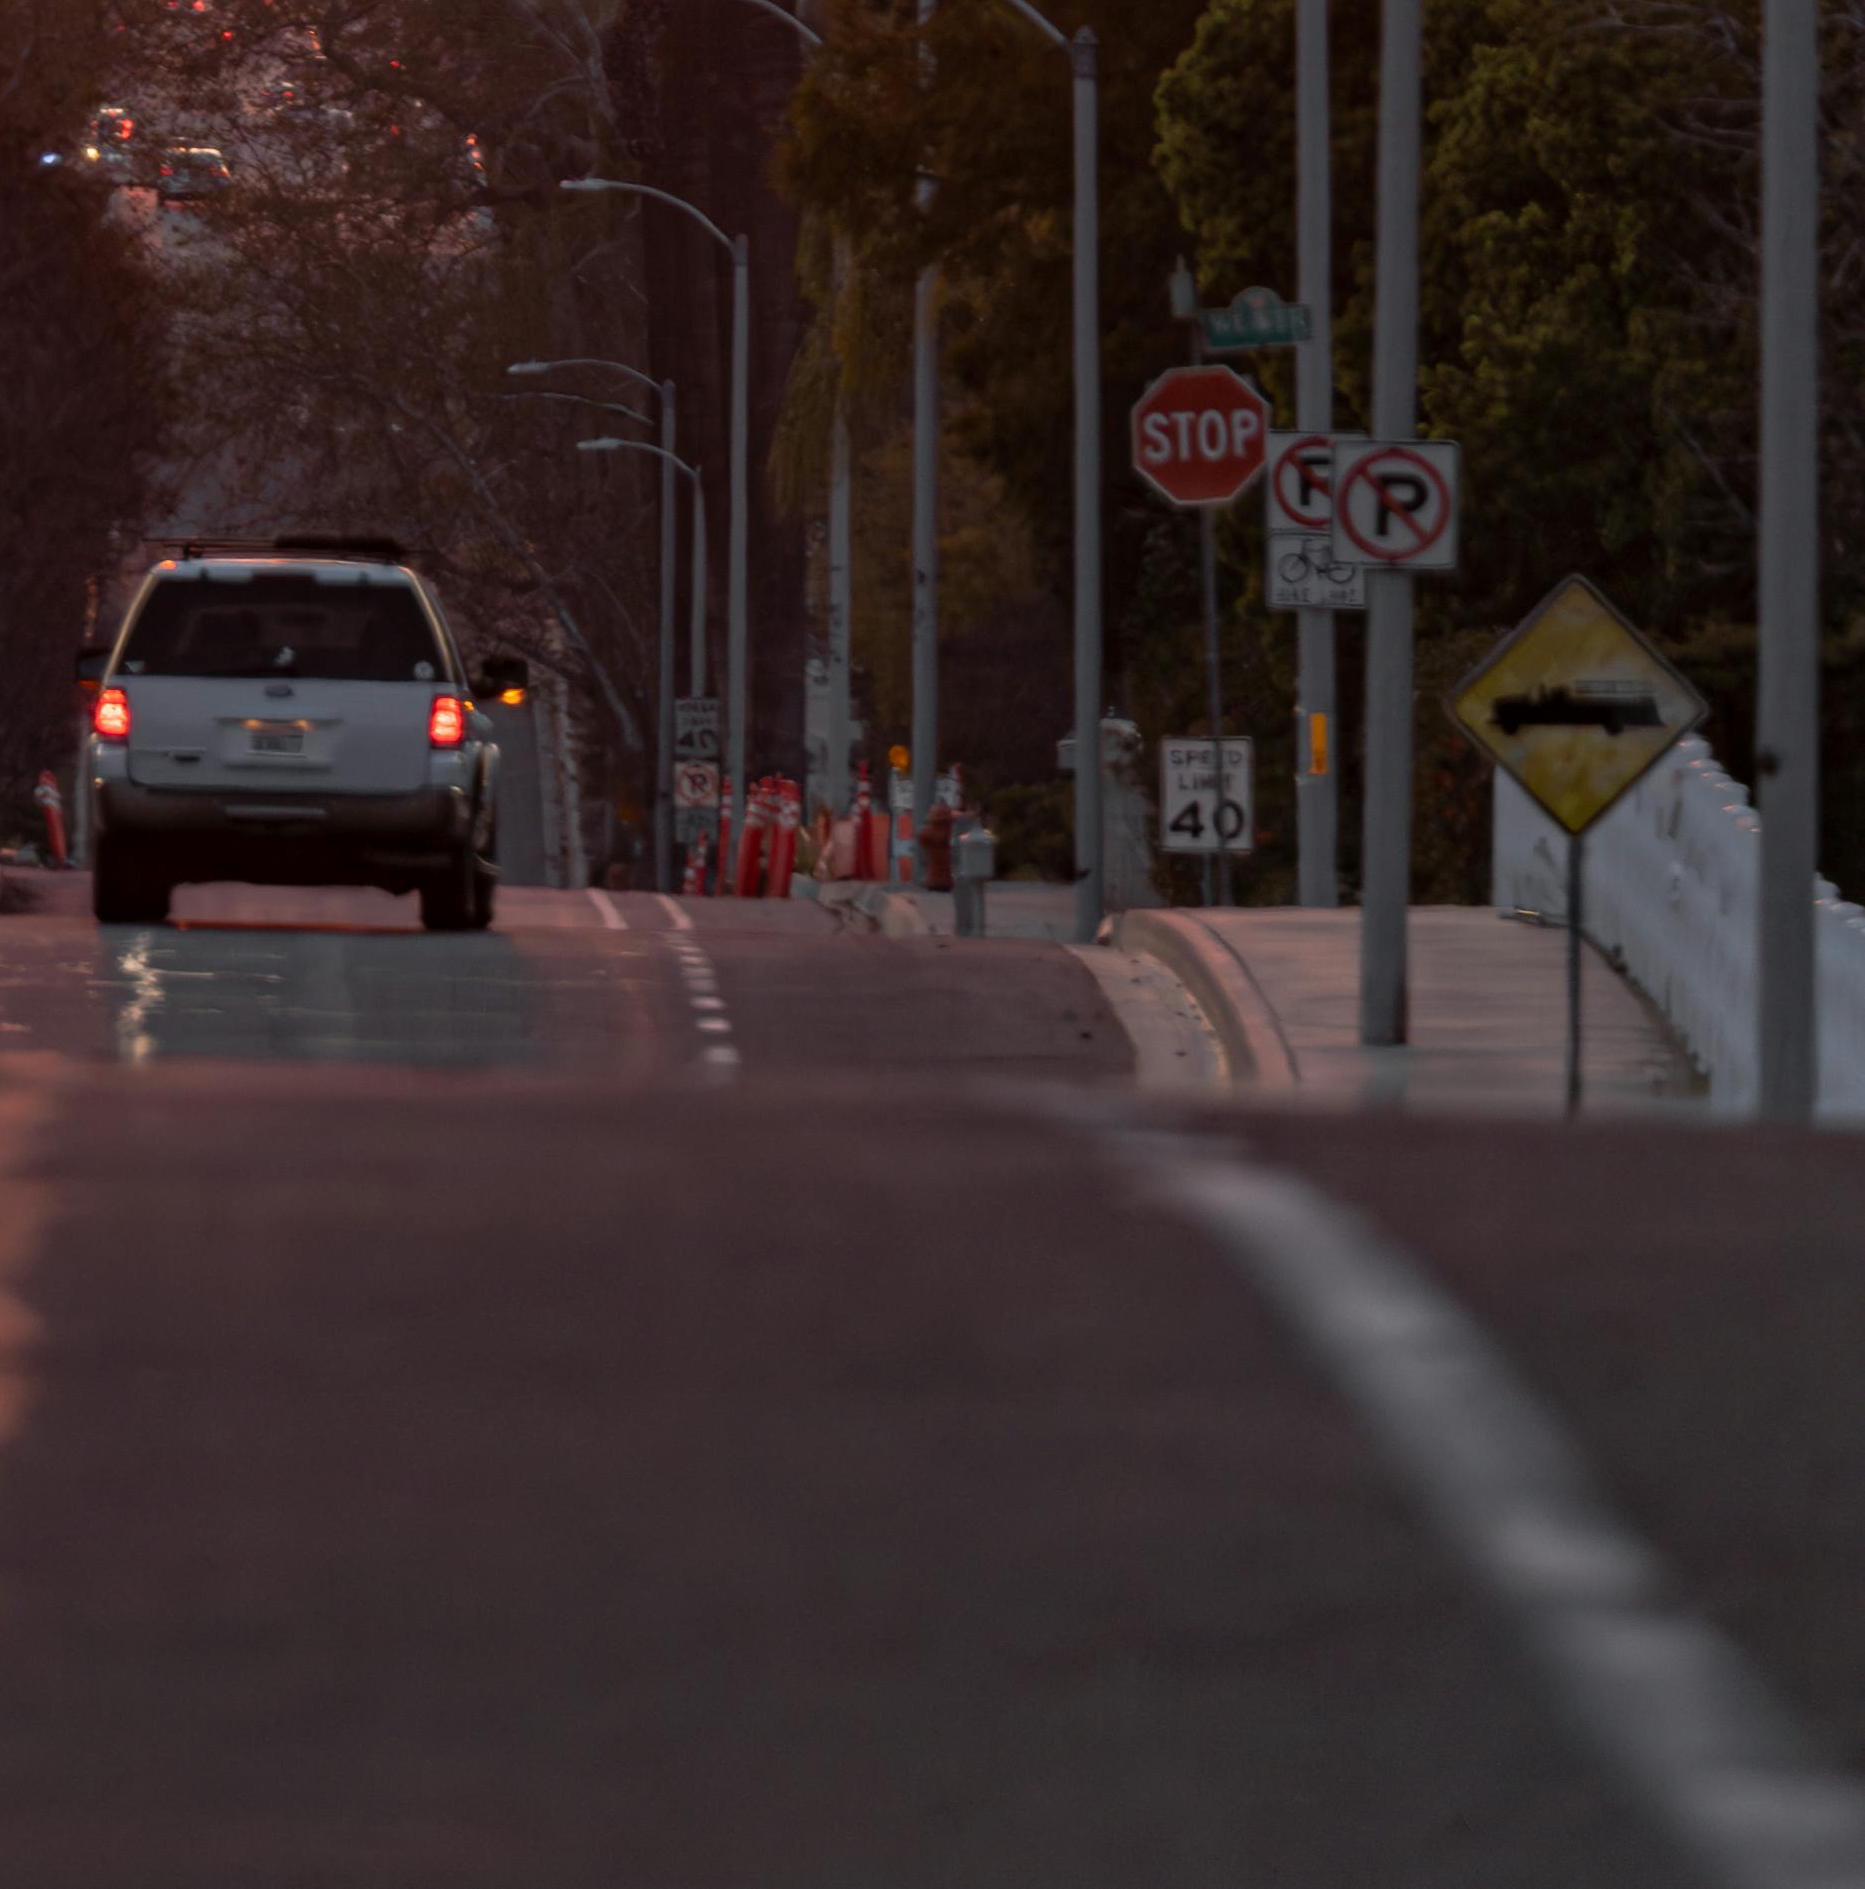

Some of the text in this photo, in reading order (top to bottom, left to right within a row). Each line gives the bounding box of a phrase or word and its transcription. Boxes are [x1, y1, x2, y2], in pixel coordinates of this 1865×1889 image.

[1143, 409, 1259, 464] STOP
[1374, 472, 1428, 537] P
[1170, 750, 1243, 766] SPED
[1178, 773, 1235, 791] LIMT
[1170, 800, 1244, 840] 40
